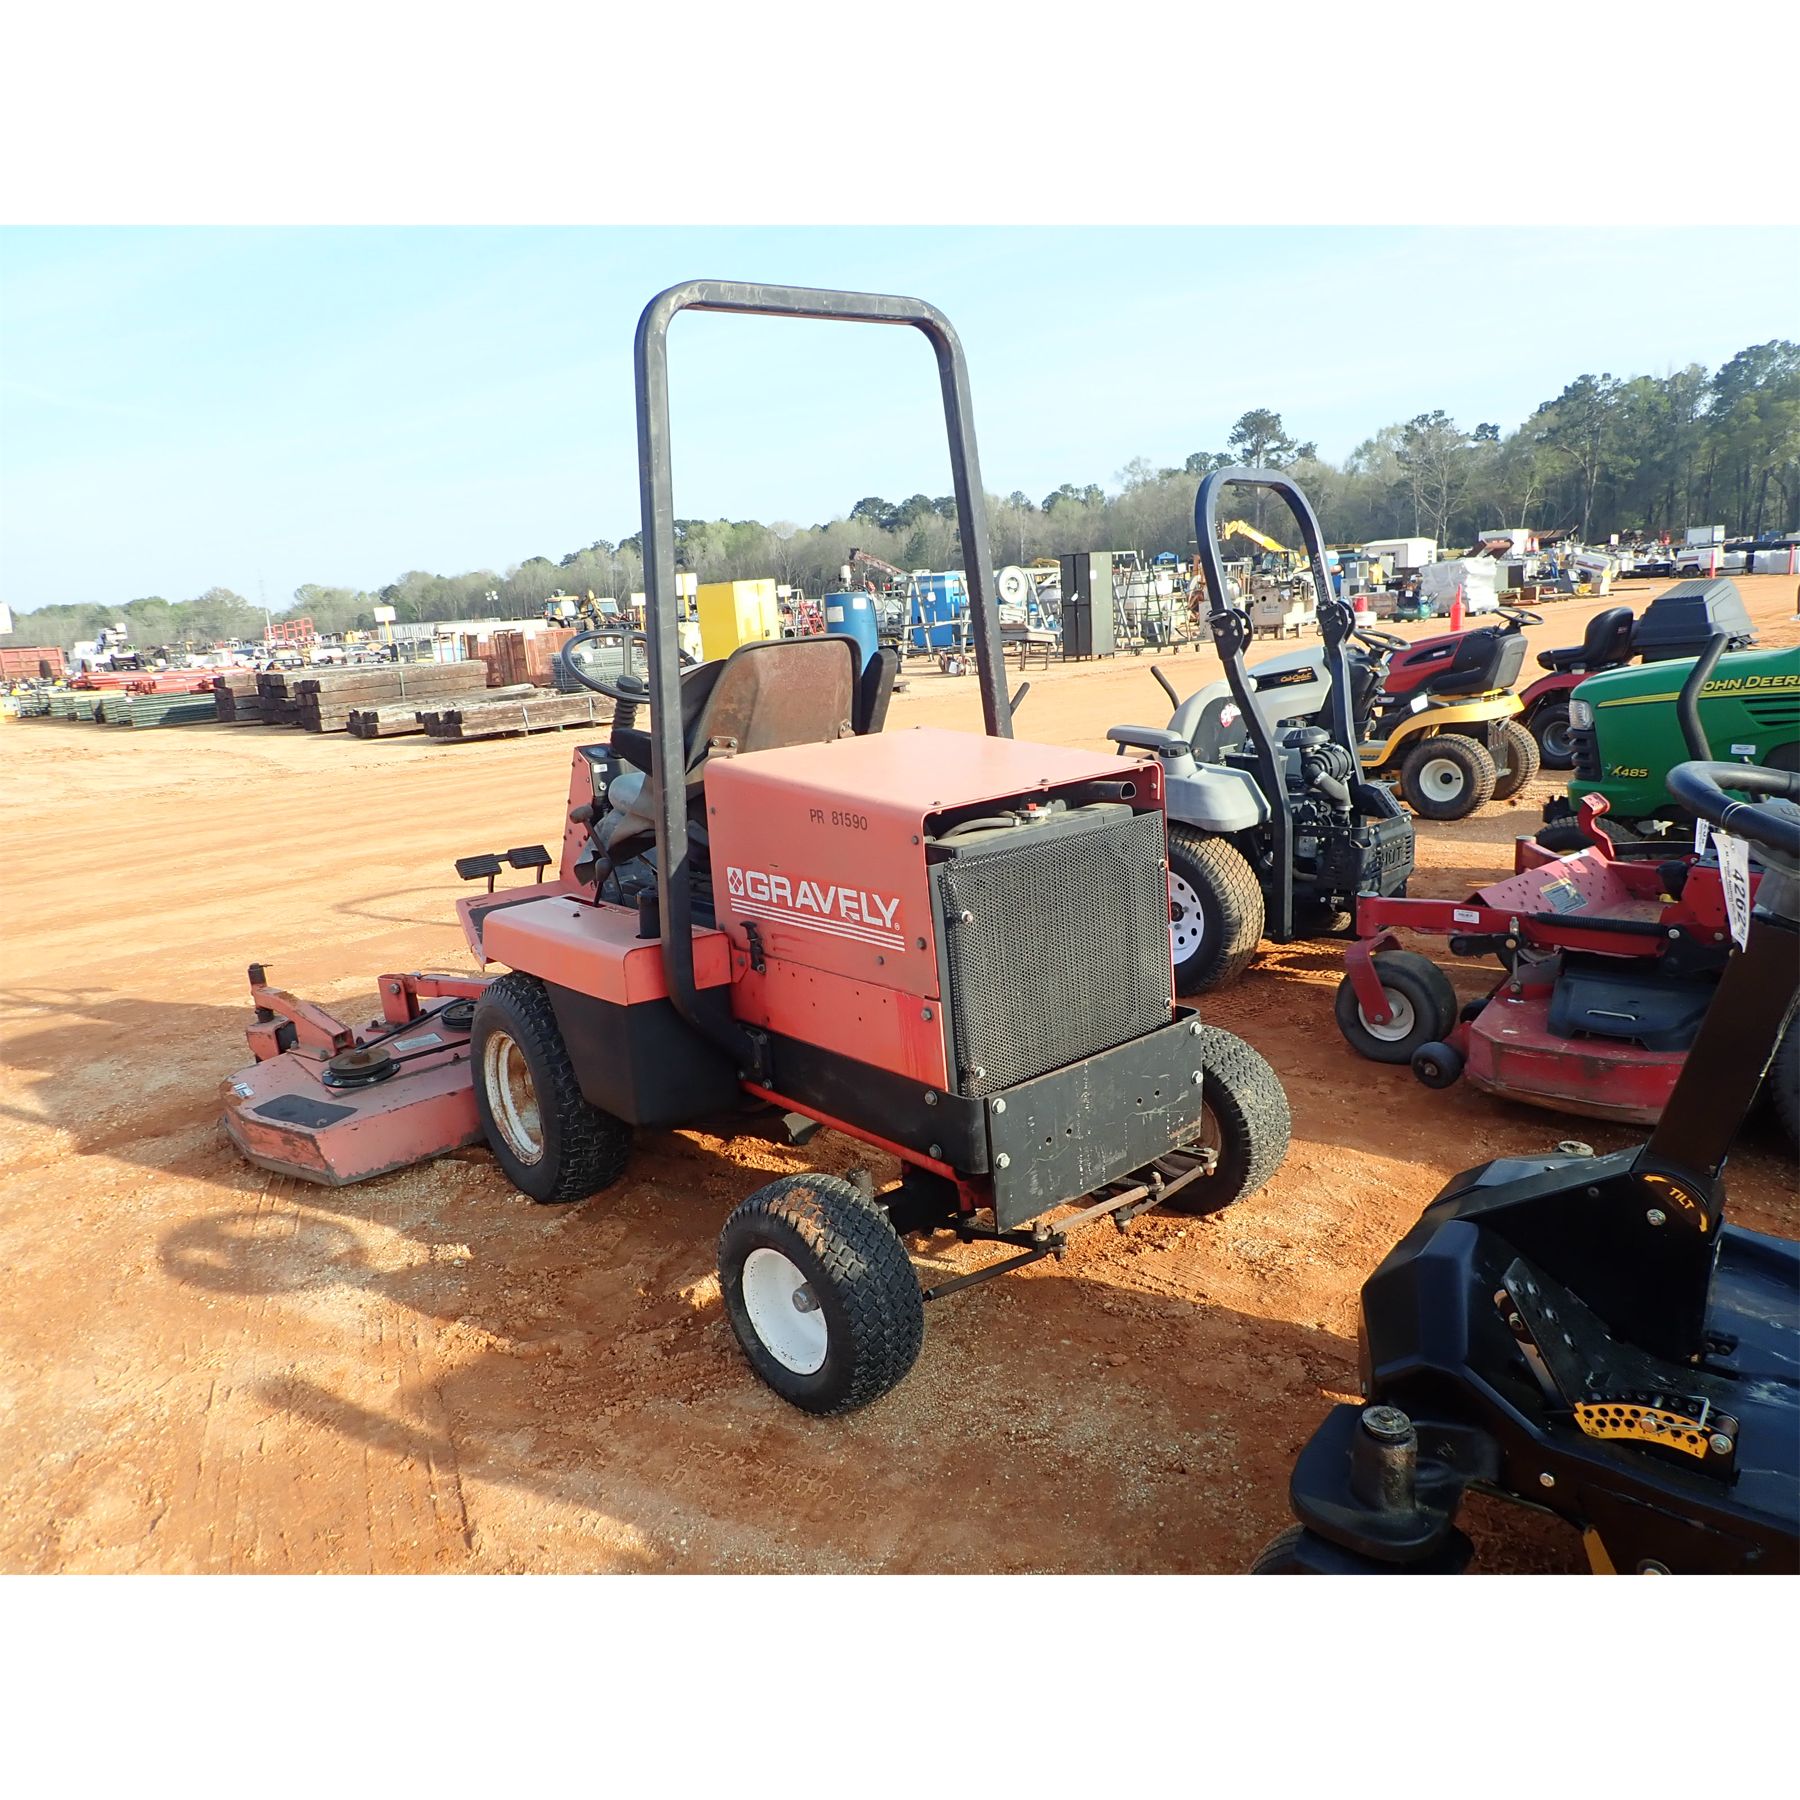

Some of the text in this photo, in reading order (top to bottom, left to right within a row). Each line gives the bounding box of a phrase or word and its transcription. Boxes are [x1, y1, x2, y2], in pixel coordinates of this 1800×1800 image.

[1703, 678, 1743, 691] OHN
[809, 808, 868, 831] PR 81590
[745, 870, 900, 928] GRAVELY
[1733, 868, 1746, 927] 4262
[1669, 1187, 1695, 1209] TILT
